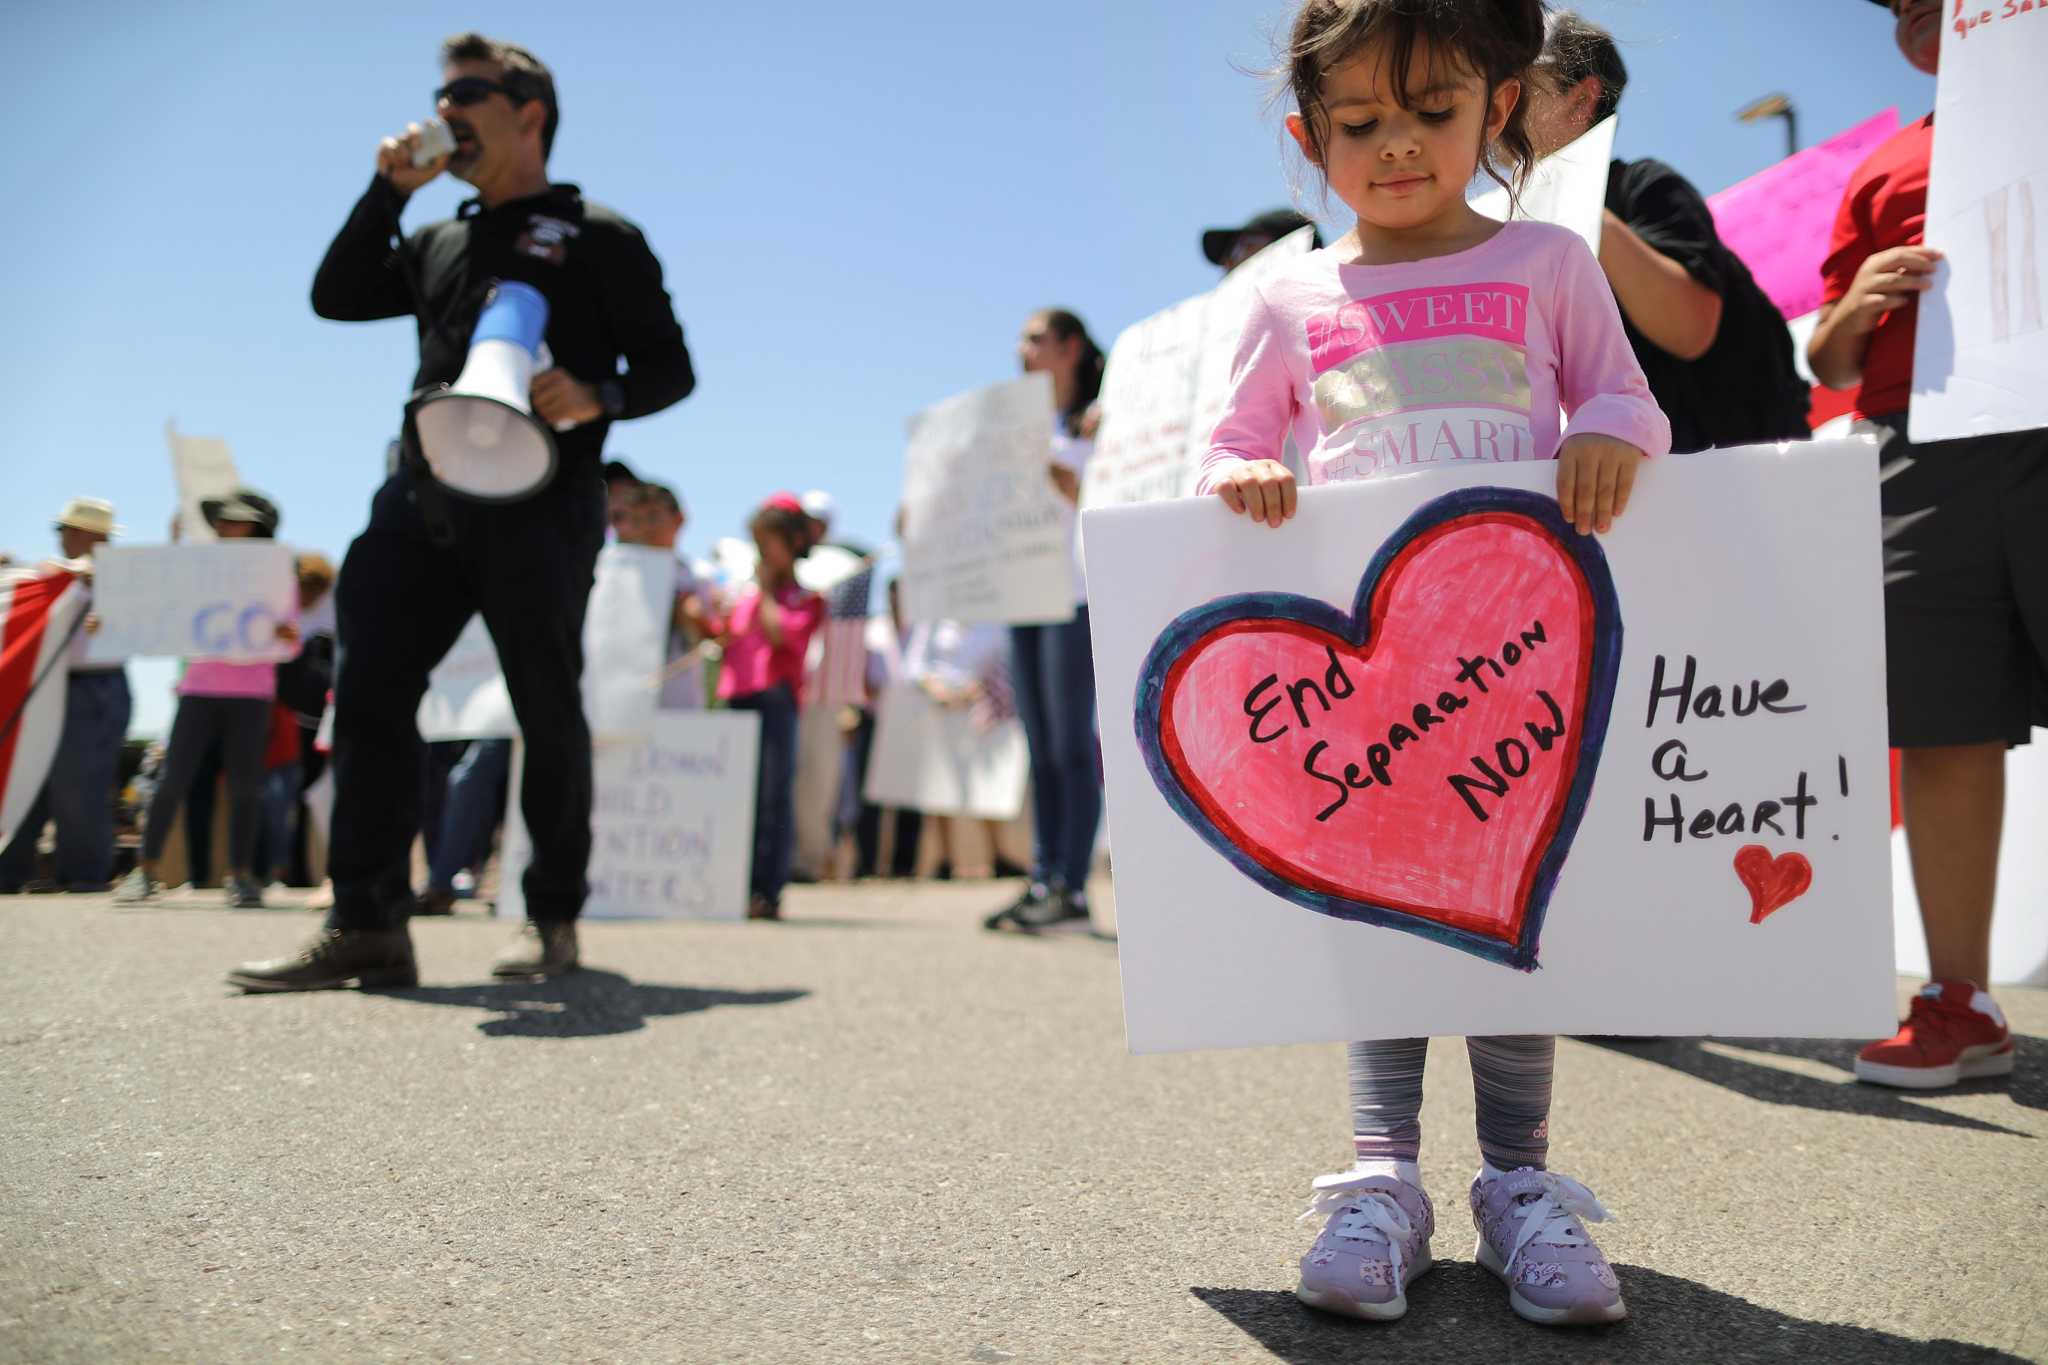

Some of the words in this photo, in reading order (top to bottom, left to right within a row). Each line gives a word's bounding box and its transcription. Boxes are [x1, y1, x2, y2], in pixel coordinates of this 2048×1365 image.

[1305, 291, 1521, 359] #SWEET
[1331, 418, 1530, 479] #SMART
[1243, 646, 1356, 744] End
[1646, 654, 1807, 728] Have
[1447, 690, 1566, 822] NOW
[1652, 739, 1708, 782] a
